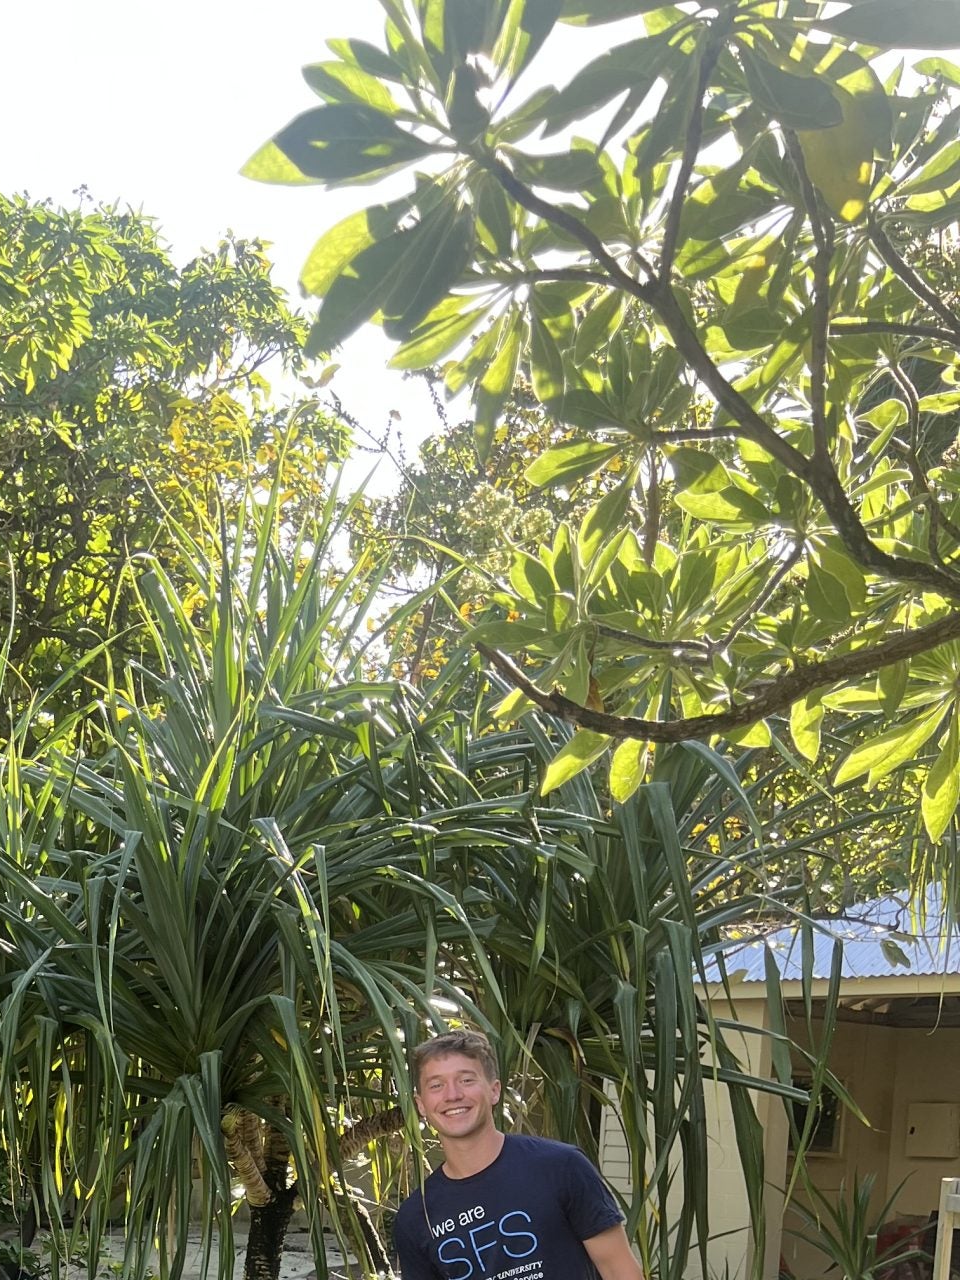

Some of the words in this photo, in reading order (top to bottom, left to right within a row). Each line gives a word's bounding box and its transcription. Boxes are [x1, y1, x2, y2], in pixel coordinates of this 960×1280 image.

[432, 1217, 455, 1238] we
[458, 1205, 485, 1227] are
[496, 1260, 543, 1280] UNIVERSITY
